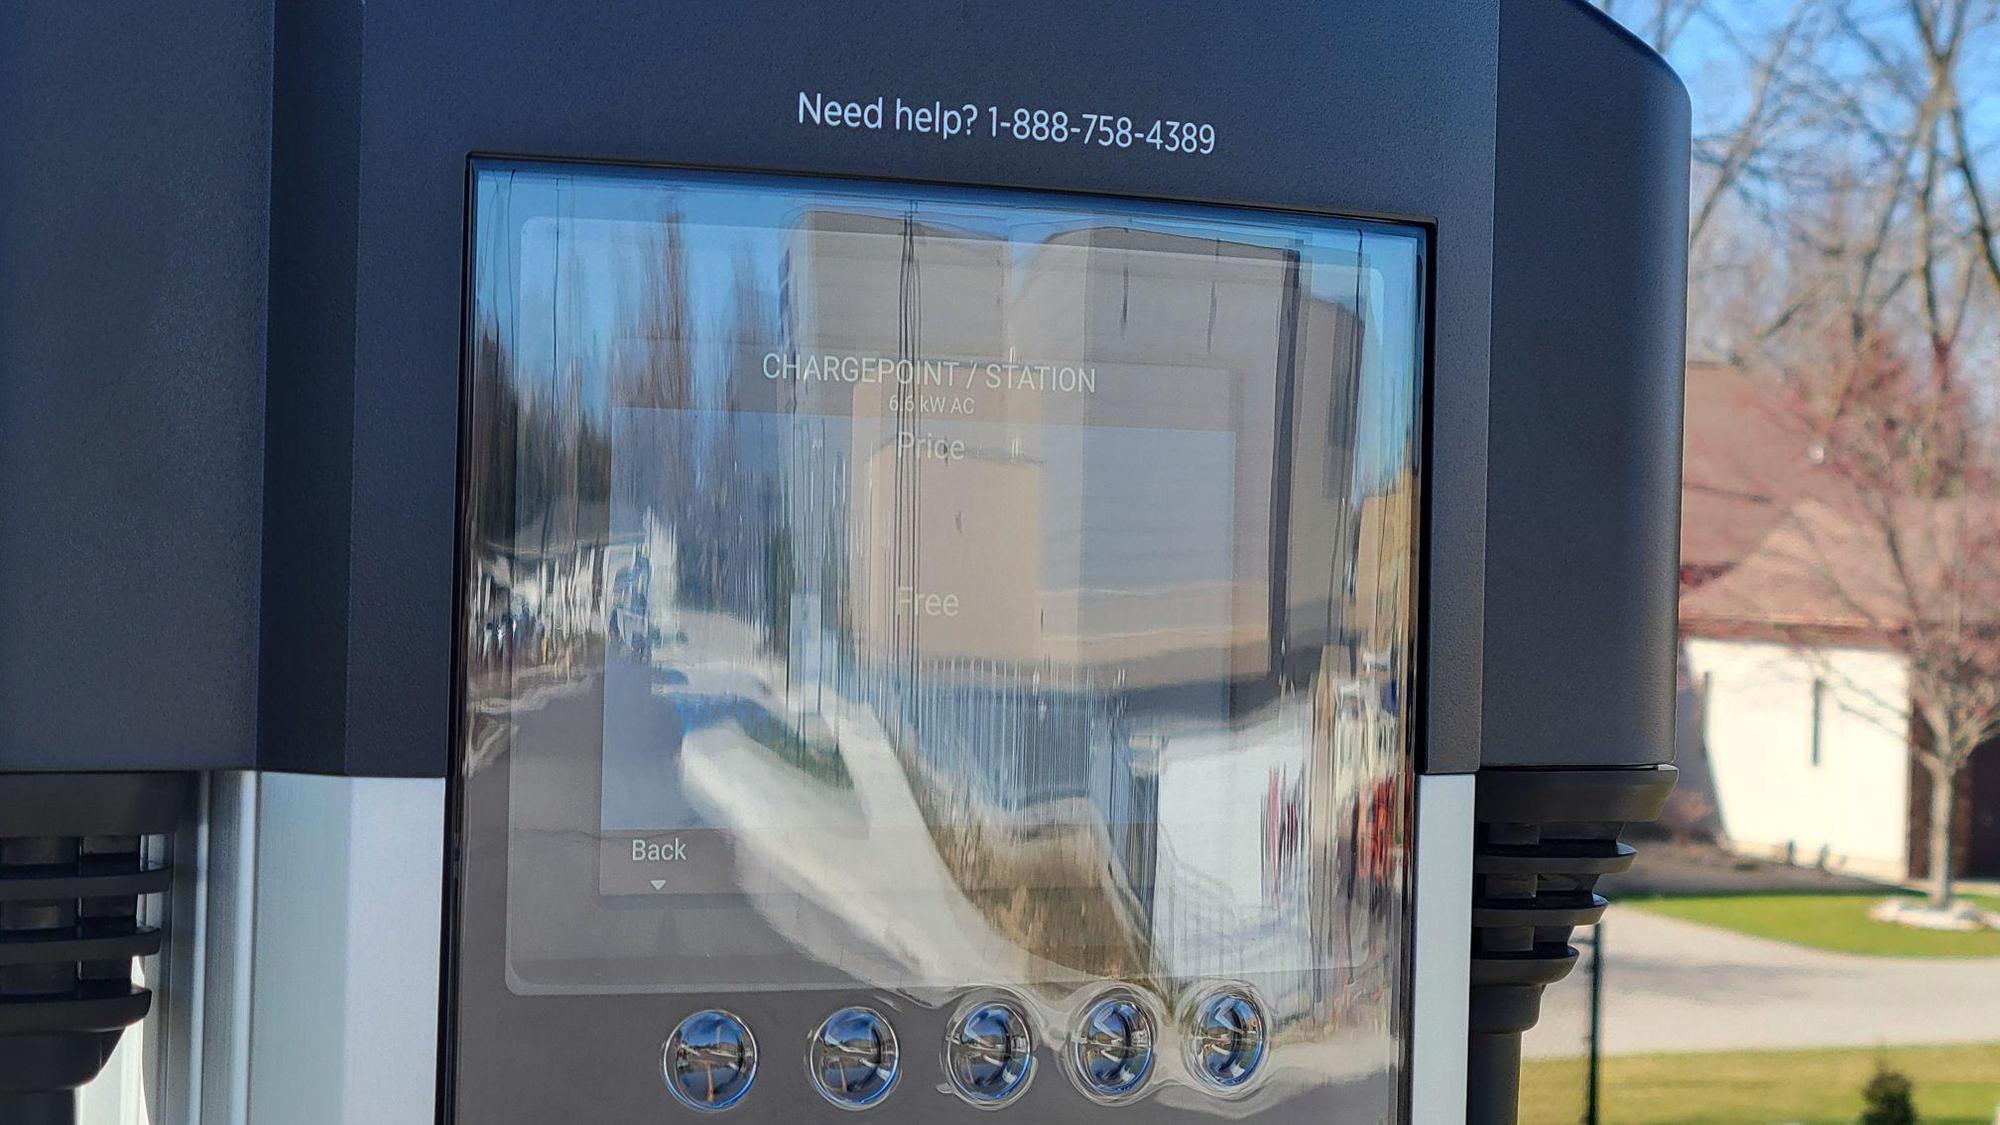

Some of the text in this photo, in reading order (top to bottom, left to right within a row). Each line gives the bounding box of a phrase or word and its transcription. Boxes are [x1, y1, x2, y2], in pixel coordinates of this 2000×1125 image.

[798, 91, 1216, 155] Need help? 1-888-758-4389
[762, 353, 1097, 393] CHARGEPOINT / STATION
[920, 395, 947, 414] kW
[951, 397, 976, 415] AC
[897, 431, 966, 460] Price
[896, 586, 959, 617] Free
[632, 837, 687, 861] Back
